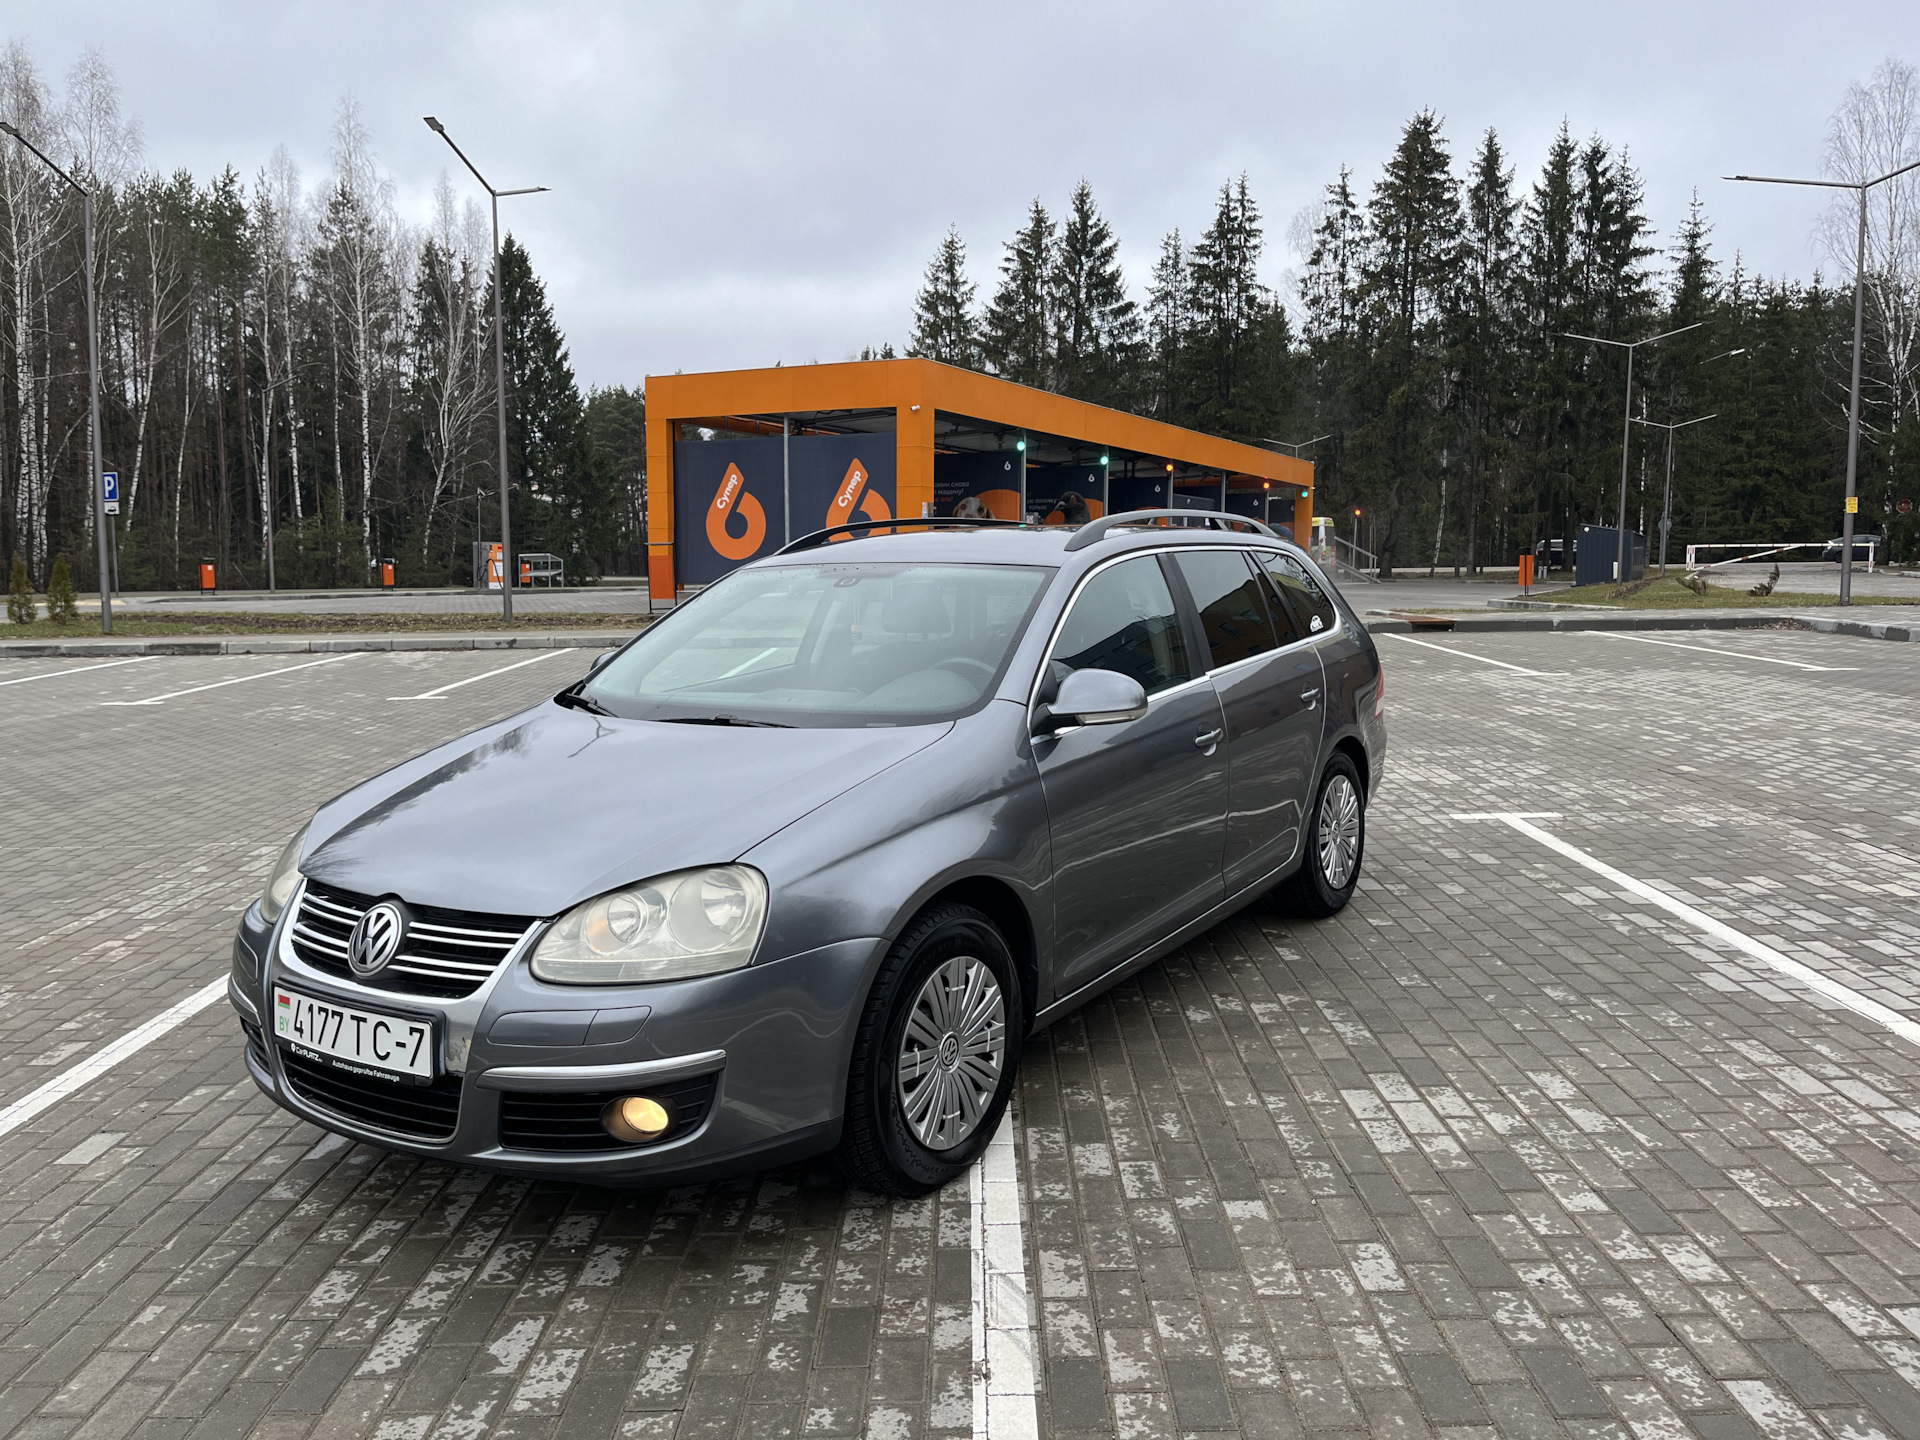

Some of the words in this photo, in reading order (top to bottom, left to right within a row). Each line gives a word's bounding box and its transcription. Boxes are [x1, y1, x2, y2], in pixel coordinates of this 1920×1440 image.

[103, 475, 115, 498] P
[716, 473, 738, 510] Супер
[837, 470, 862, 508] Супер
[279, 1015, 290, 1033] BY
[293, 999, 345, 1050] 4177
